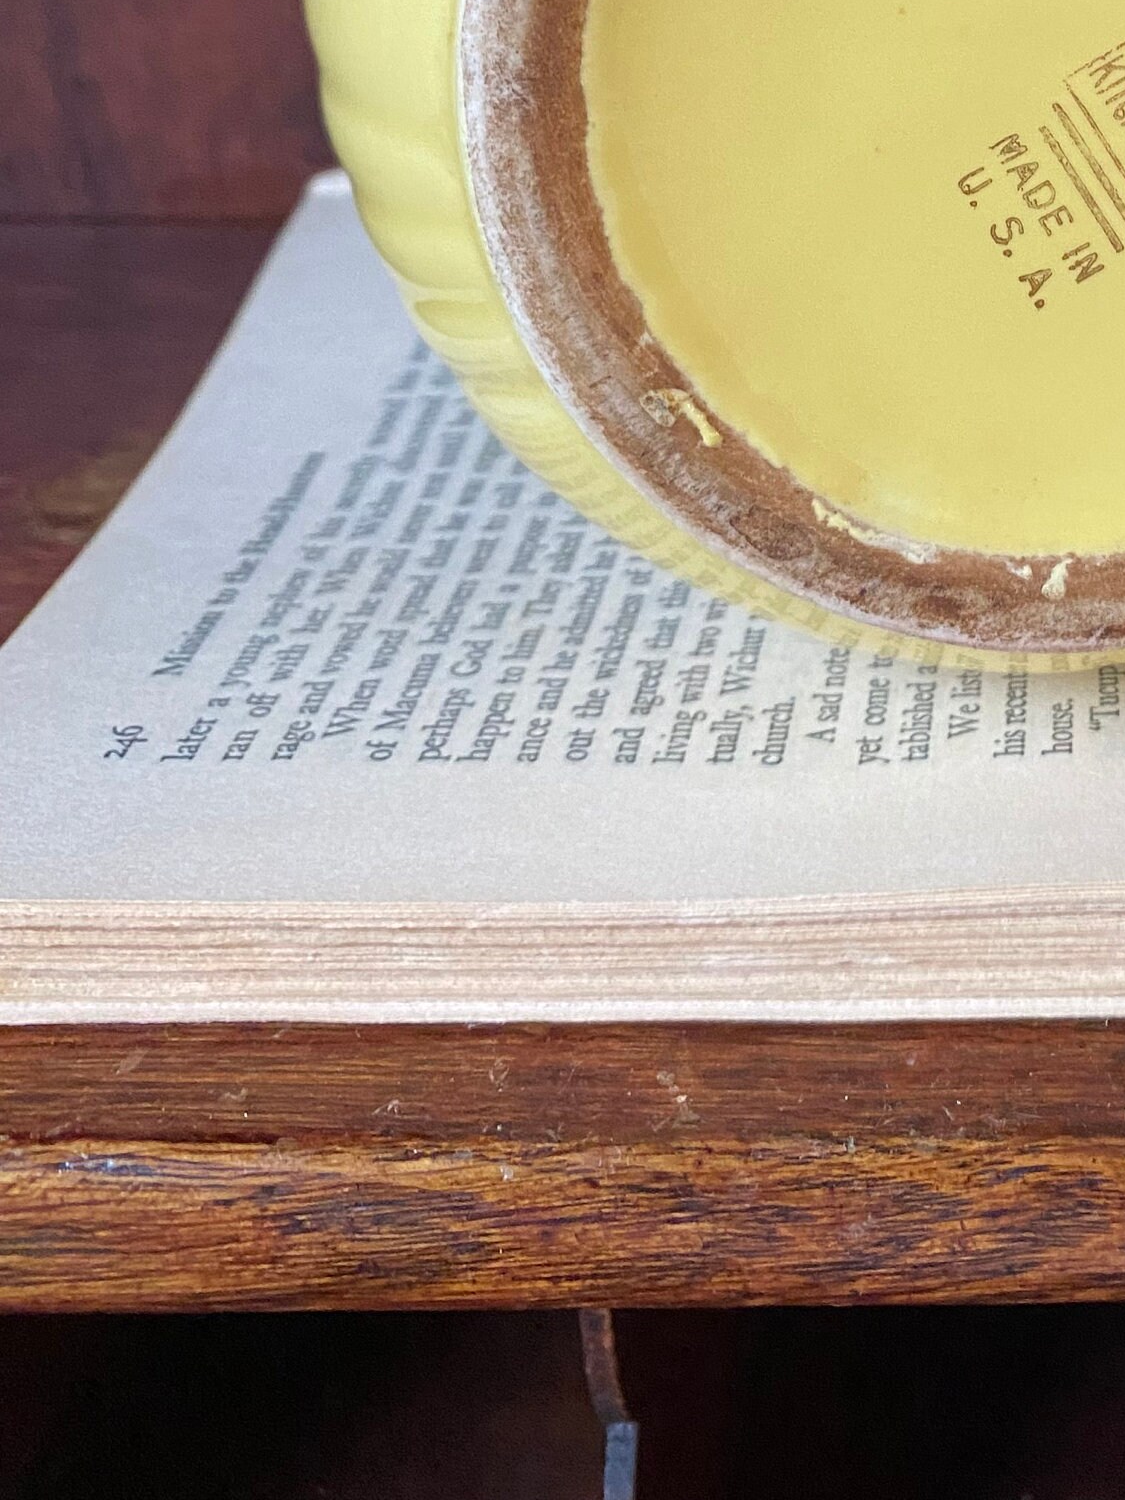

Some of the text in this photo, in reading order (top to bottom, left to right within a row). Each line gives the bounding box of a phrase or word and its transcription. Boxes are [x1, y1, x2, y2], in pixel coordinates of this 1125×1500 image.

[989, 133, 1104, 284] MADE IN
[151, 611, 224, 677] Mission
[502, 625, 543, 660] him.
[645, 616, 684, 650] that
[689, 626, 721, 656] two
[219, 635, 278, 688] young
[222, 730, 258, 761] ran
[243, 692, 278, 717] off
[270, 644, 308, 681] with
[292, 604, 333, 633] her.
[322, 679, 381, 738] When
[369, 630, 407, 669] word
[418, 688, 475, 762] perhaps
[454, 640, 493, 678] God
[475, 602, 512, 630] had
[496, 666, 525, 684] to
[543, 651, 578, 670] he
[677, 664, 716, 703] with
[211, 697, 229, 707] a
[271, 720, 314, 761] rage
[298, 681, 334, 714] and
[320, 622, 367, 673] vowed
[374, 653, 438, 730] Macuma
[534, 678, 570, 710] and
[576, 689, 610, 719] the
[628, 660, 667, 716] agreed
[709, 627, 766, 764] tually, Wichur
[805, 647, 850, 743] A sad note
[862, 678, 890, 725] come
[161, 717, 218, 762] later
[459, 692, 516, 762] happen
[517, 717, 553, 762] ance
[654, 709, 704, 763] living
[752, 697, 796, 765] church.
[900, 682, 936, 761] tablished
[994, 672, 1028, 758] his recent
[1042, 698, 1073, 755] house.
[103, 725, 147, 758] 246
[369, 738, 394, 762] of
[564, 729, 595, 761] out
[613, 727, 645, 763] and
[856, 736, 889, 764] yet
